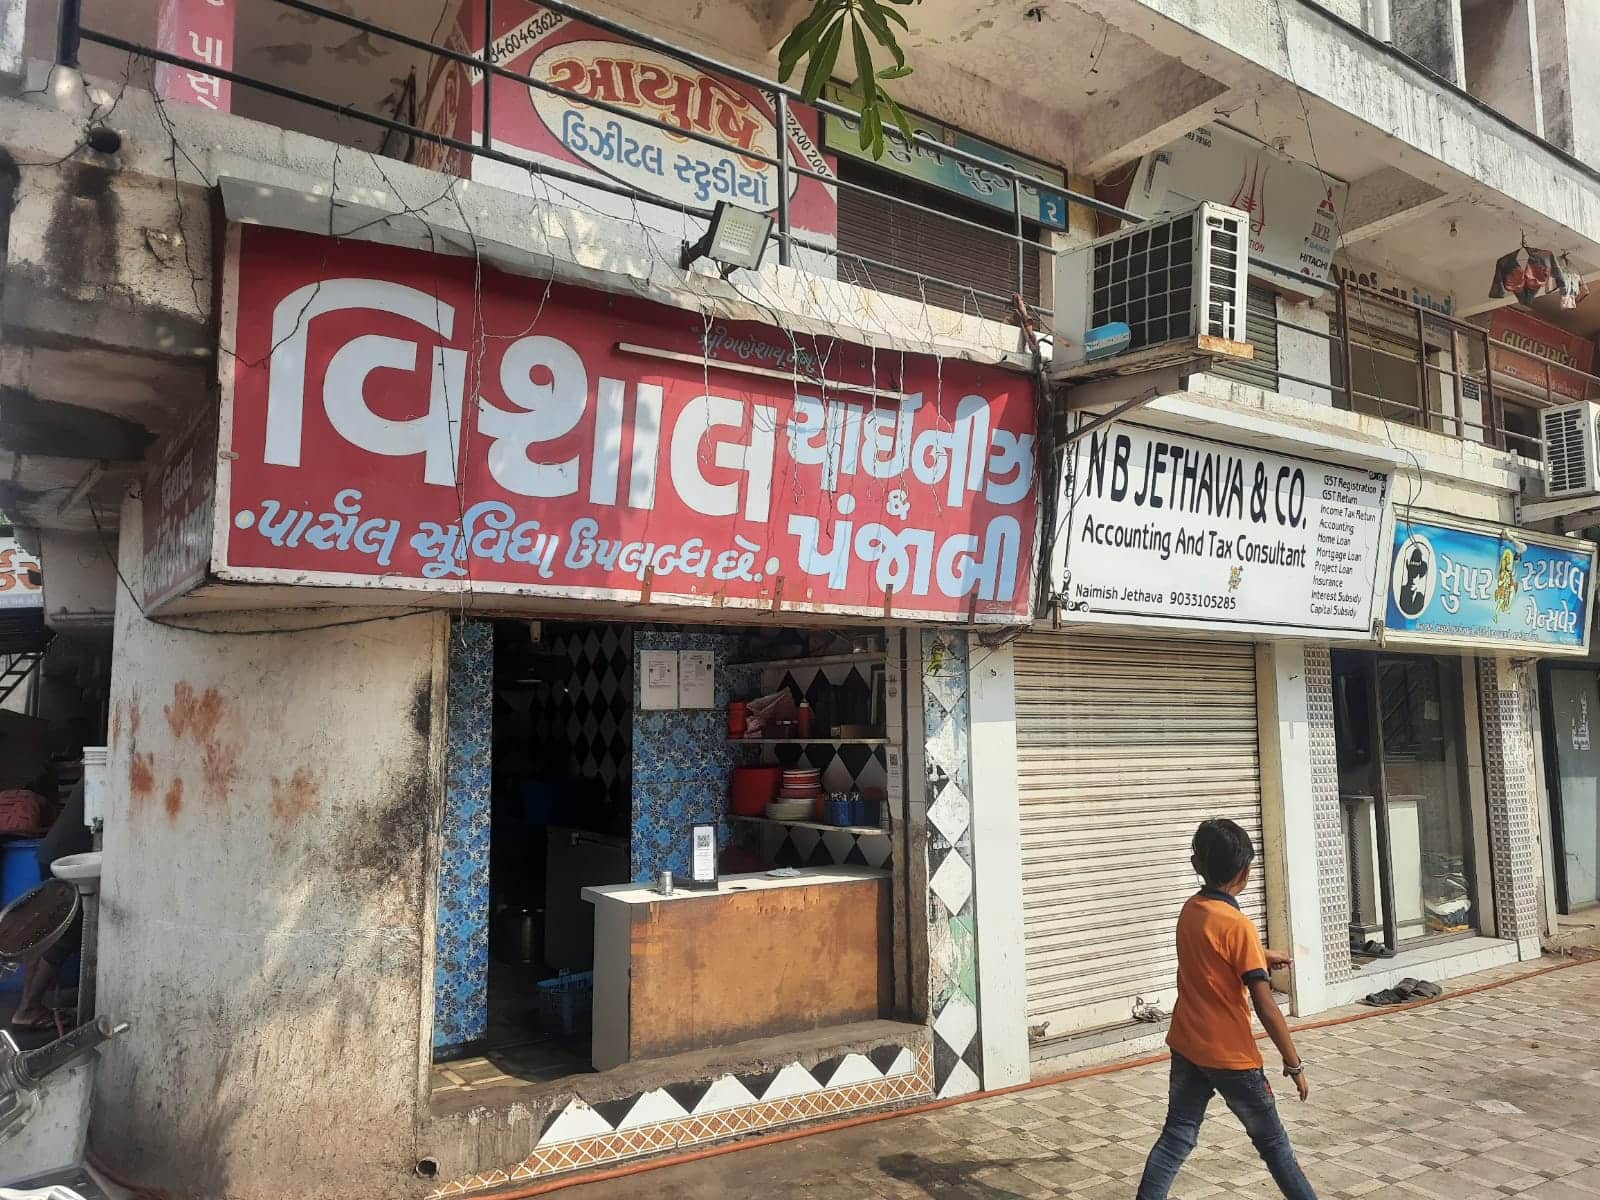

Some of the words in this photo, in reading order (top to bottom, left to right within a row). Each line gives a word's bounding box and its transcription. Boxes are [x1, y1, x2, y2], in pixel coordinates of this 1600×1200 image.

[1300, 252, 1328, 271] HITACHI
[263, 277, 778, 523] વિશાલ
[1134, 441, 1243, 520] JETHAVA
[1250, 460, 1268, 524] &
[1275, 465, 1308, 530] CO.
[1323, 475, 1338, 486] GST
[1339, 477, 1377, 493] Registration
[886, 488, 911, 520] &
[1322, 489, 1337, 501] GST
[1338, 491, 1358, 505] Return
[1320, 504, 1343, 517] Income
[1344, 507, 1355, 519] Tax
[1355, 509, 1376, 523] Return
[1319, 518, 1355, 535] Accounting
[787, 493, 1021, 602] પંજાબી
[1081, 514, 1171, 560] Accounting
[1175, 527, 1203, 557] And
[1208, 529, 1232, 560] Tax
[1236, 534, 1307, 568] Consultant
[1318, 533, 1336, 545] Home
[1336, 535, 1351, 546] Loan
[1316, 546, 1347, 562] Mortgage
[1347, 550, 1362, 562] Loan
[1314, 560, 1338, 575] Project
[1338, 563, 1353, 575] Loan
[1313, 575, 1343, 588] Insurance
[1439, 552, 1494, 614] સુપર
[1075, 583, 1118, 600] Naimish
[1121, 587, 1163, 604] Jethava
[1170, 591, 1237, 610] 9033105285
[1311, 589, 1337, 602] Interest
[1338, 591, 1362, 605] Subsidy
[1310, 603, 1332, 617] Capital
[1333, 604, 1356, 618] Subsidy
